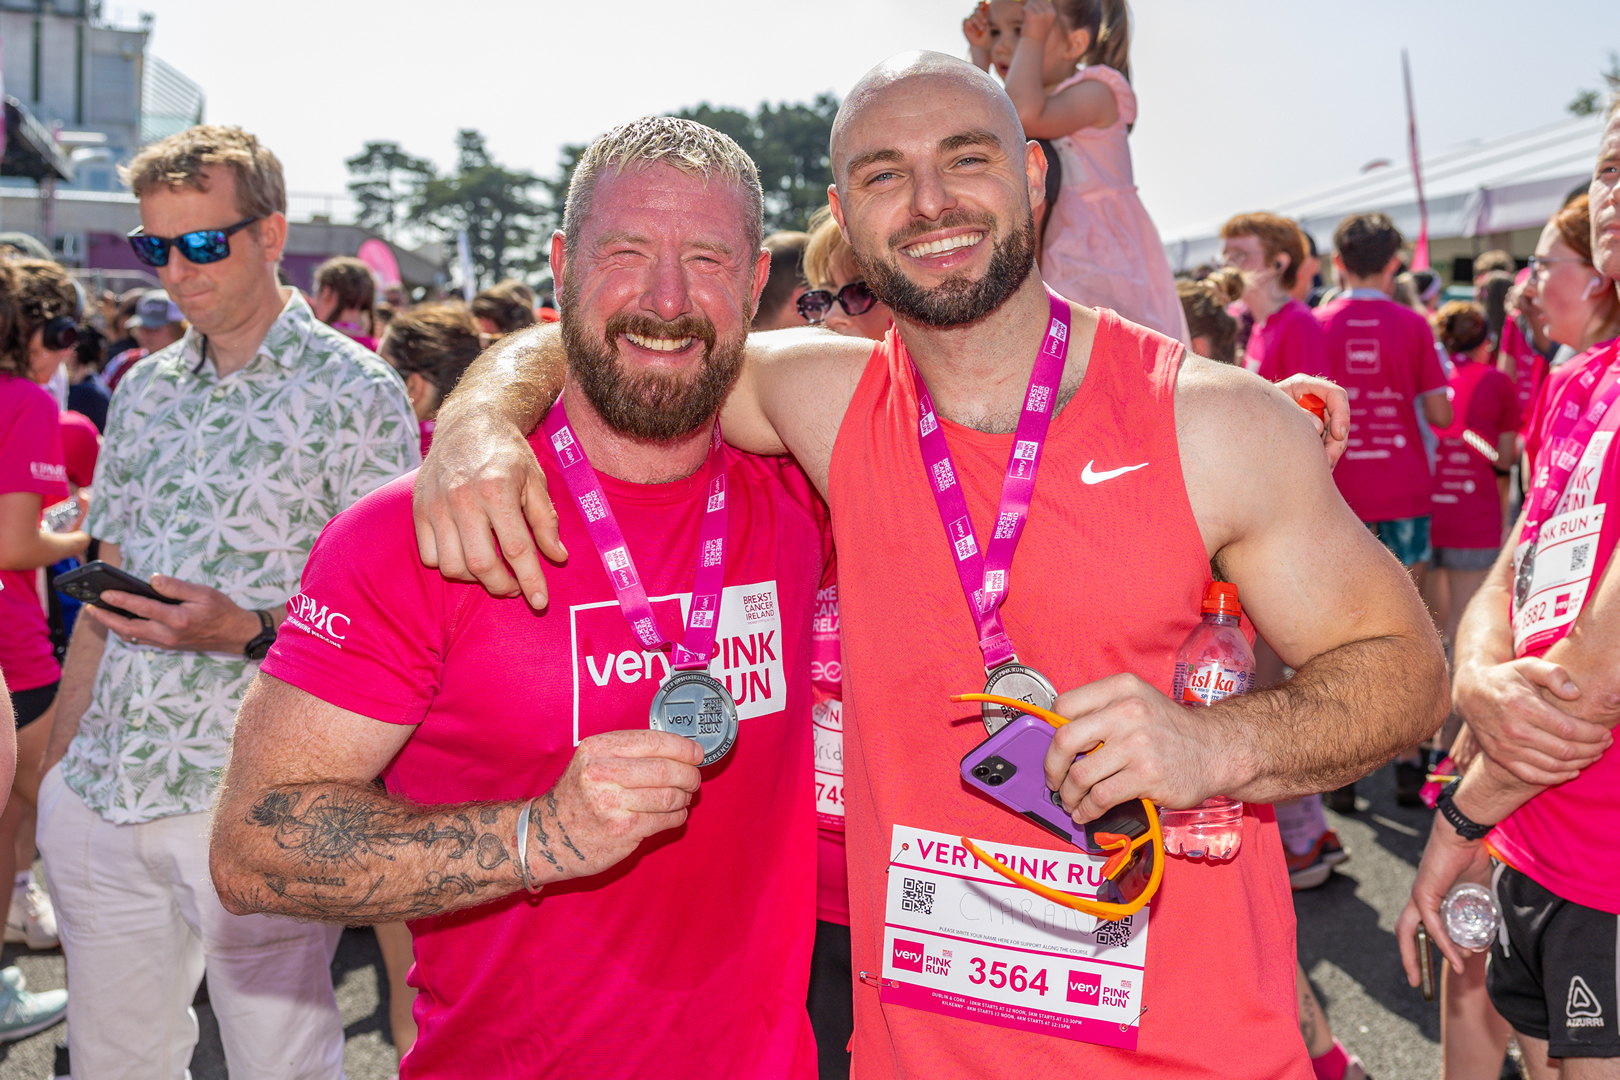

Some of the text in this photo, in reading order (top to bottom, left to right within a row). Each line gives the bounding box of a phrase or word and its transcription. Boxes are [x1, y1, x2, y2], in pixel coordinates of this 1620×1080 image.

[1050, 338, 1060, 354] very
[1032, 385, 1044, 412] CANCER
[1038, 386, 1050, 414] IRELAND
[1022, 442, 1030, 458] PINK
[1028, 444, 1036, 459] RUN
[938, 460, 950, 490] CANCER
[1016, 460, 1026, 476] very
[932, 463, 946, 492] IRELAND
[584, 492, 601, 520] CANCER
[590, 490, 606, 518] IRELAND
[956, 520, 966, 538] very
[1000, 512, 1014, 540] CANCER
[1006, 512, 1019, 540] IRELAND
[1559, 515, 1588, 537] RUN
[956, 542, 966, 558] RUN
[962, 539, 971, 556] PINK
[618, 550, 628, 566] RUN
[618, 570, 630, 586] very
[700, 596, 709, 610] very
[742, 592, 772, 604] BREAST
[744, 601, 774, 613] CANCER
[288, 592, 351, 640] UPMC
[746, 610, 775, 621] IRELAND
[715, 668, 772, 706] UN
[1191, 668, 1234, 692] ishka
[668, 714, 694, 726] very
[698, 712, 723, 724] PINK
[698, 723, 721, 734] RUN
[704, 737, 732, 764] FERENCE
[1067, 863, 1104, 887] RU
[938, 926, 956, 934] PLEASE
[956, 928, 970, 936] WRITE
[970, 932, 984, 940] YOUR
[1020, 940, 1042, 949] SUPPORT
[1069, 948, 1088, 956] COURSE
[894, 948, 922, 964] very
[926, 955, 952, 968] PINK
[925, 964, 949, 976] RUN
[968, 956, 1049, 996] 3564
[1070, 982, 1098, 996] very
[1102, 986, 1130, 1000] PINK
[932, 992, 948, 1000] DUBLIN
[982, 1002, 998, 1010] STARTS
[942, 1000, 964, 1009] KILKENNY
[1102, 996, 1126, 1008] RUN
[1566, 1016, 1604, 1027] AZZURRI
